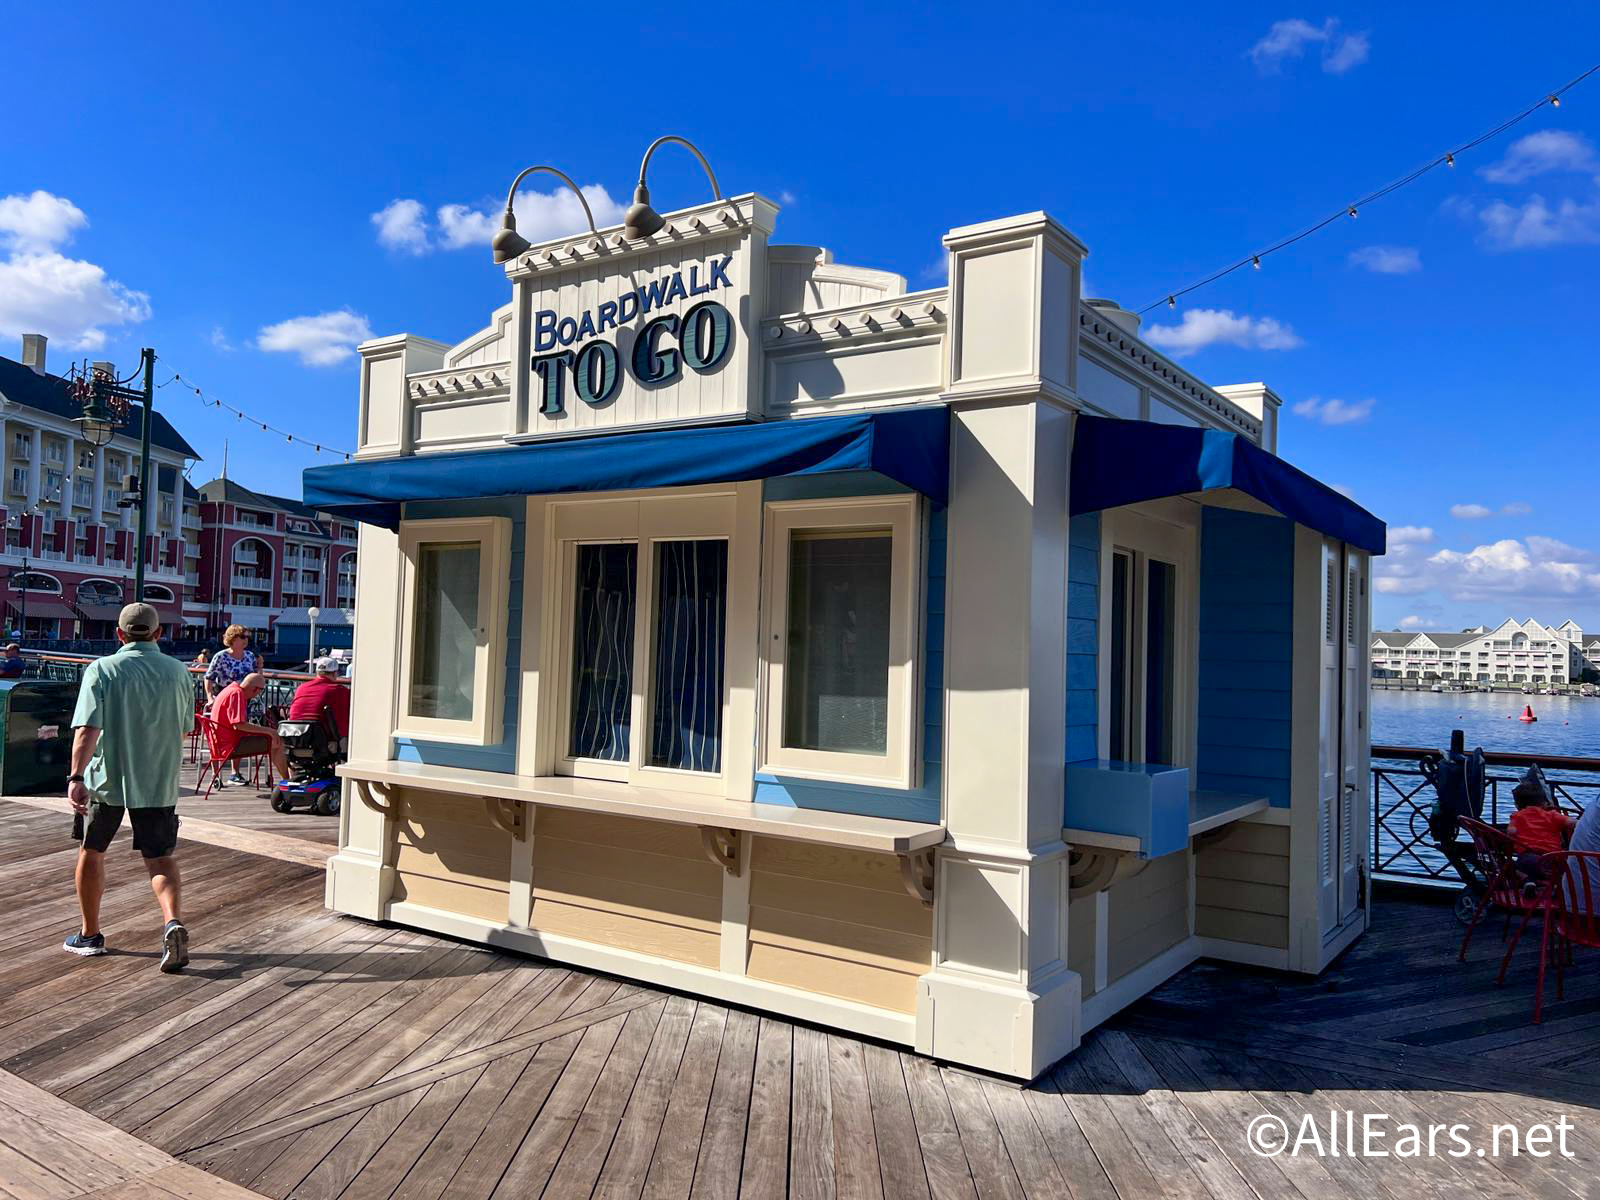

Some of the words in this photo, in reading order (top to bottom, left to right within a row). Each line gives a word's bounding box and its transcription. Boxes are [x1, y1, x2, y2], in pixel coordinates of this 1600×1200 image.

[534, 255, 733, 352] BOARDWALK
[531, 340, 619, 414] TO
[632, 300, 731, 383] GO
